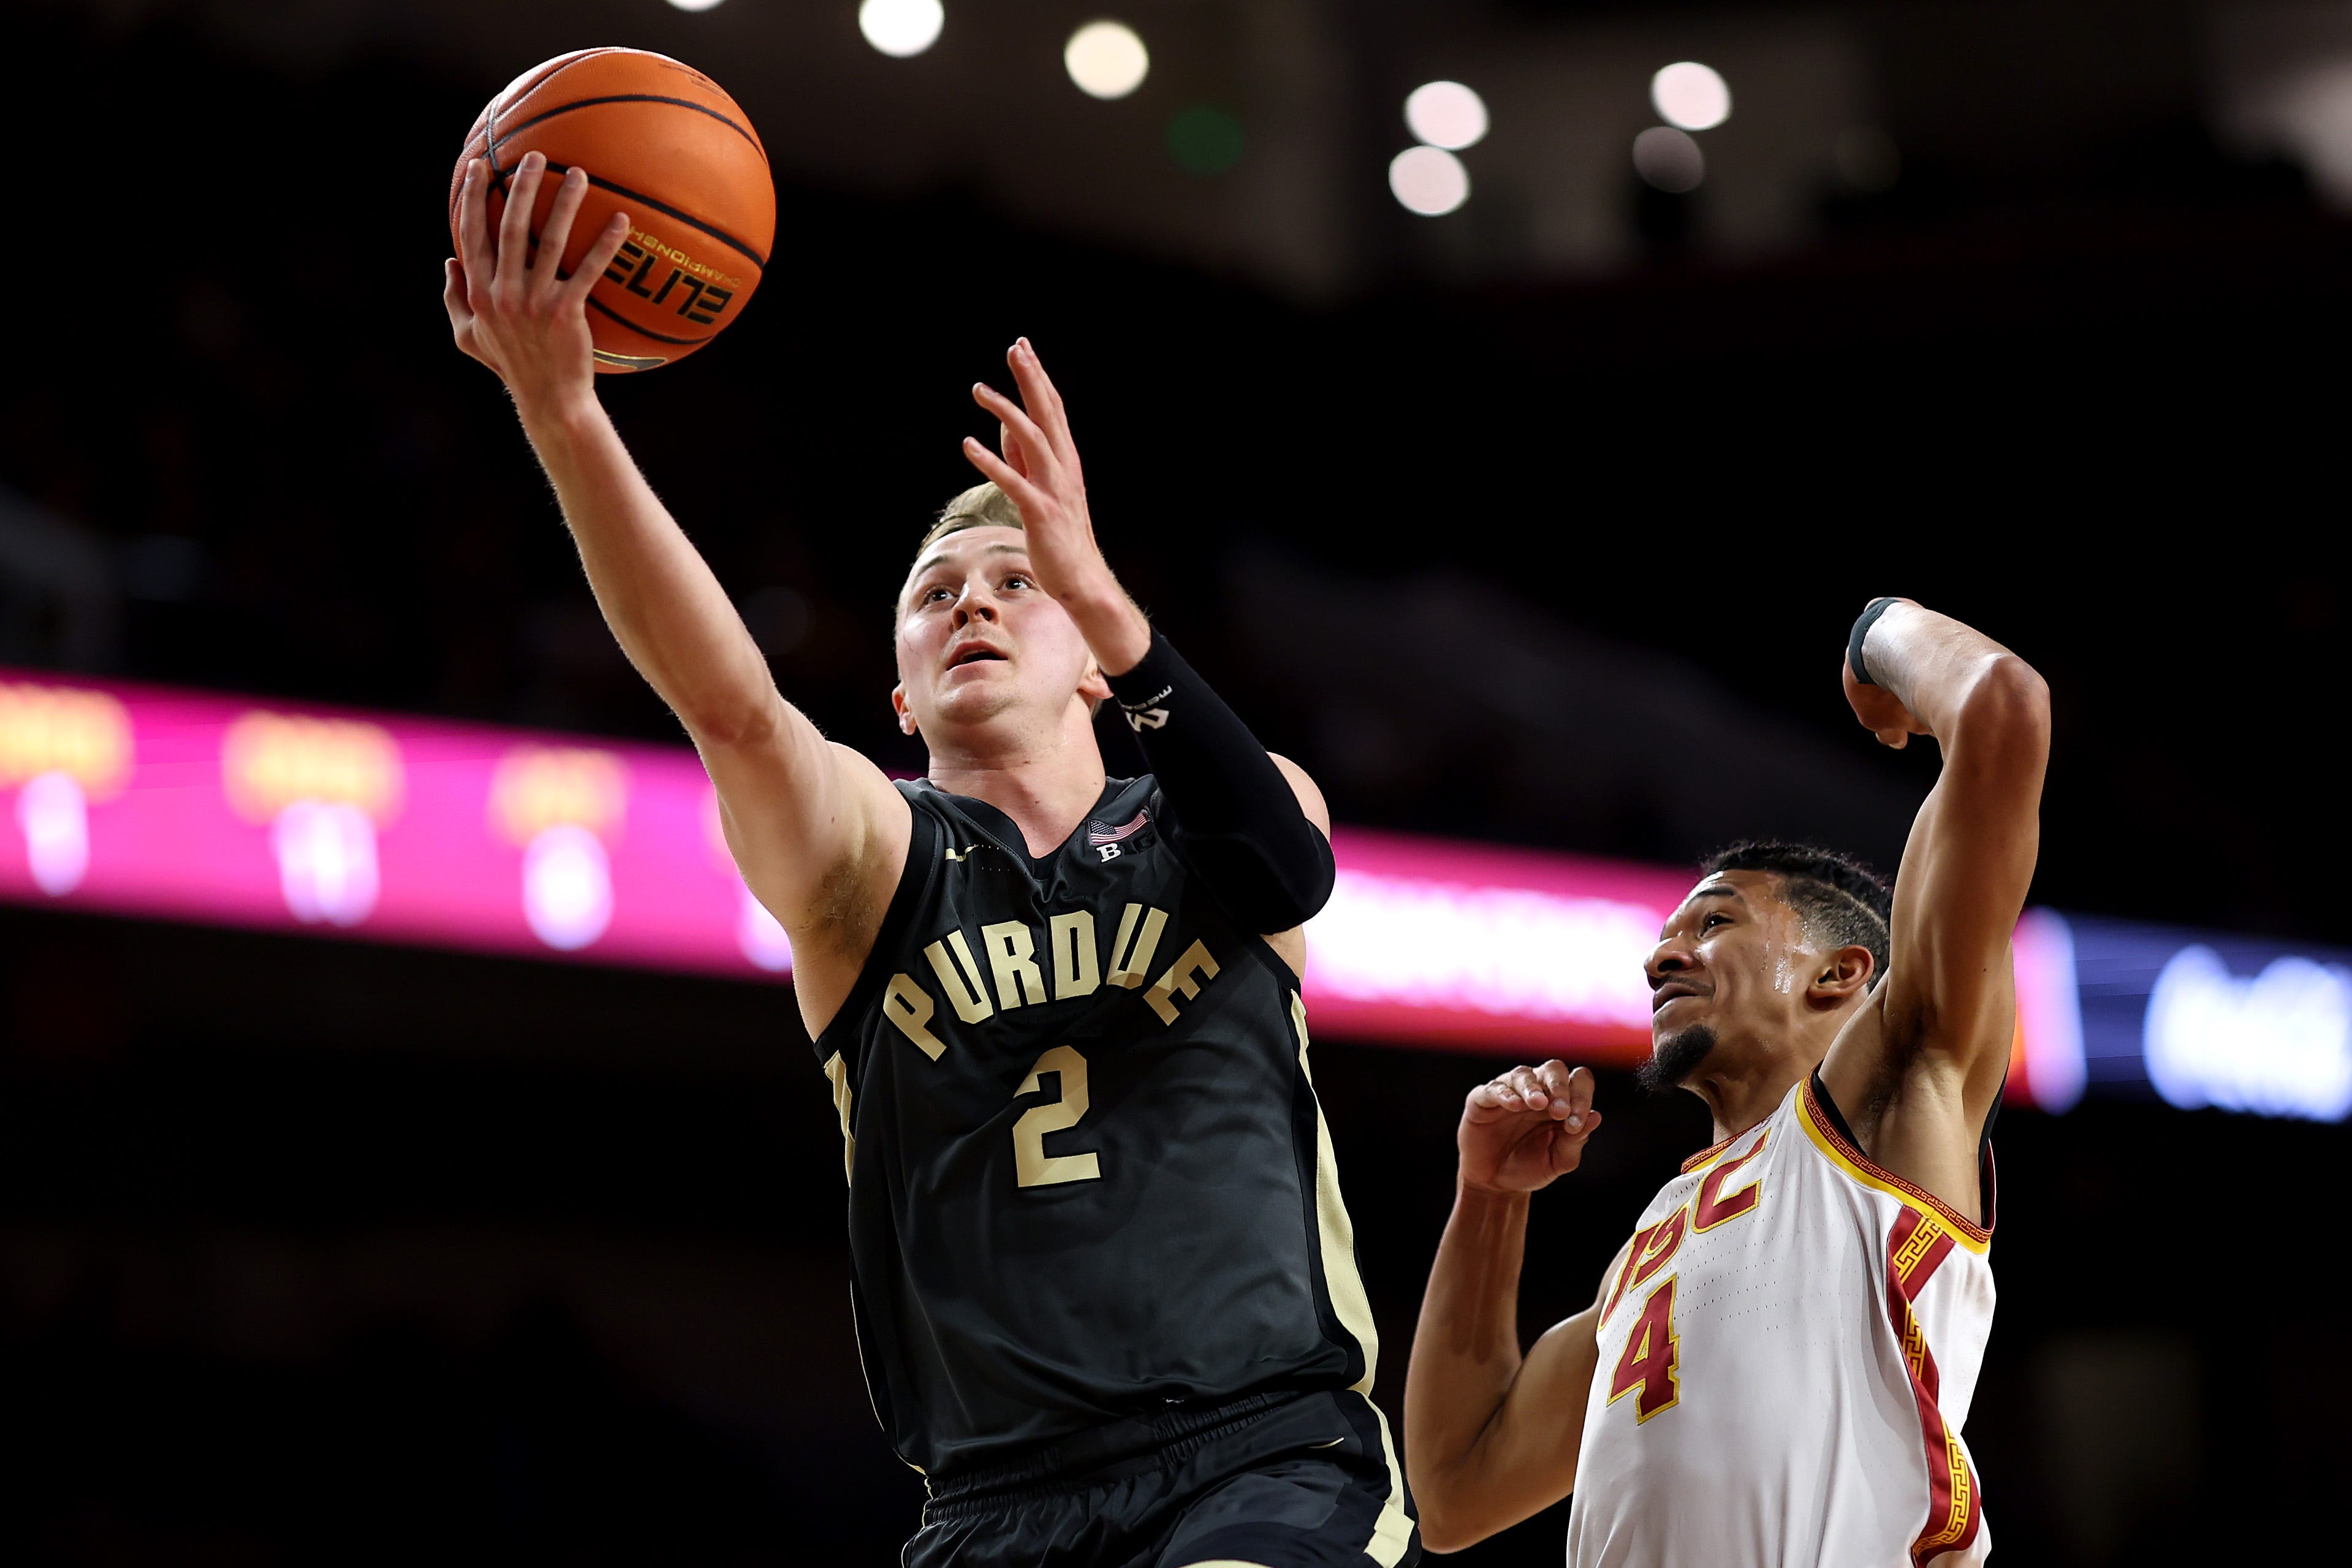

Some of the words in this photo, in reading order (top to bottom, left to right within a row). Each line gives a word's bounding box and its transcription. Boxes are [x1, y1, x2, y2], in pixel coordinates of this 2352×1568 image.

[603, 239, 734, 325] ELITE
[628, 225, 742, 288] CHAMPIONSH
[883, 903, 1220, 1061] PURDUE
[1012, 1045, 1101, 1187] 2
[1607, 1271, 1680, 1425] 4
